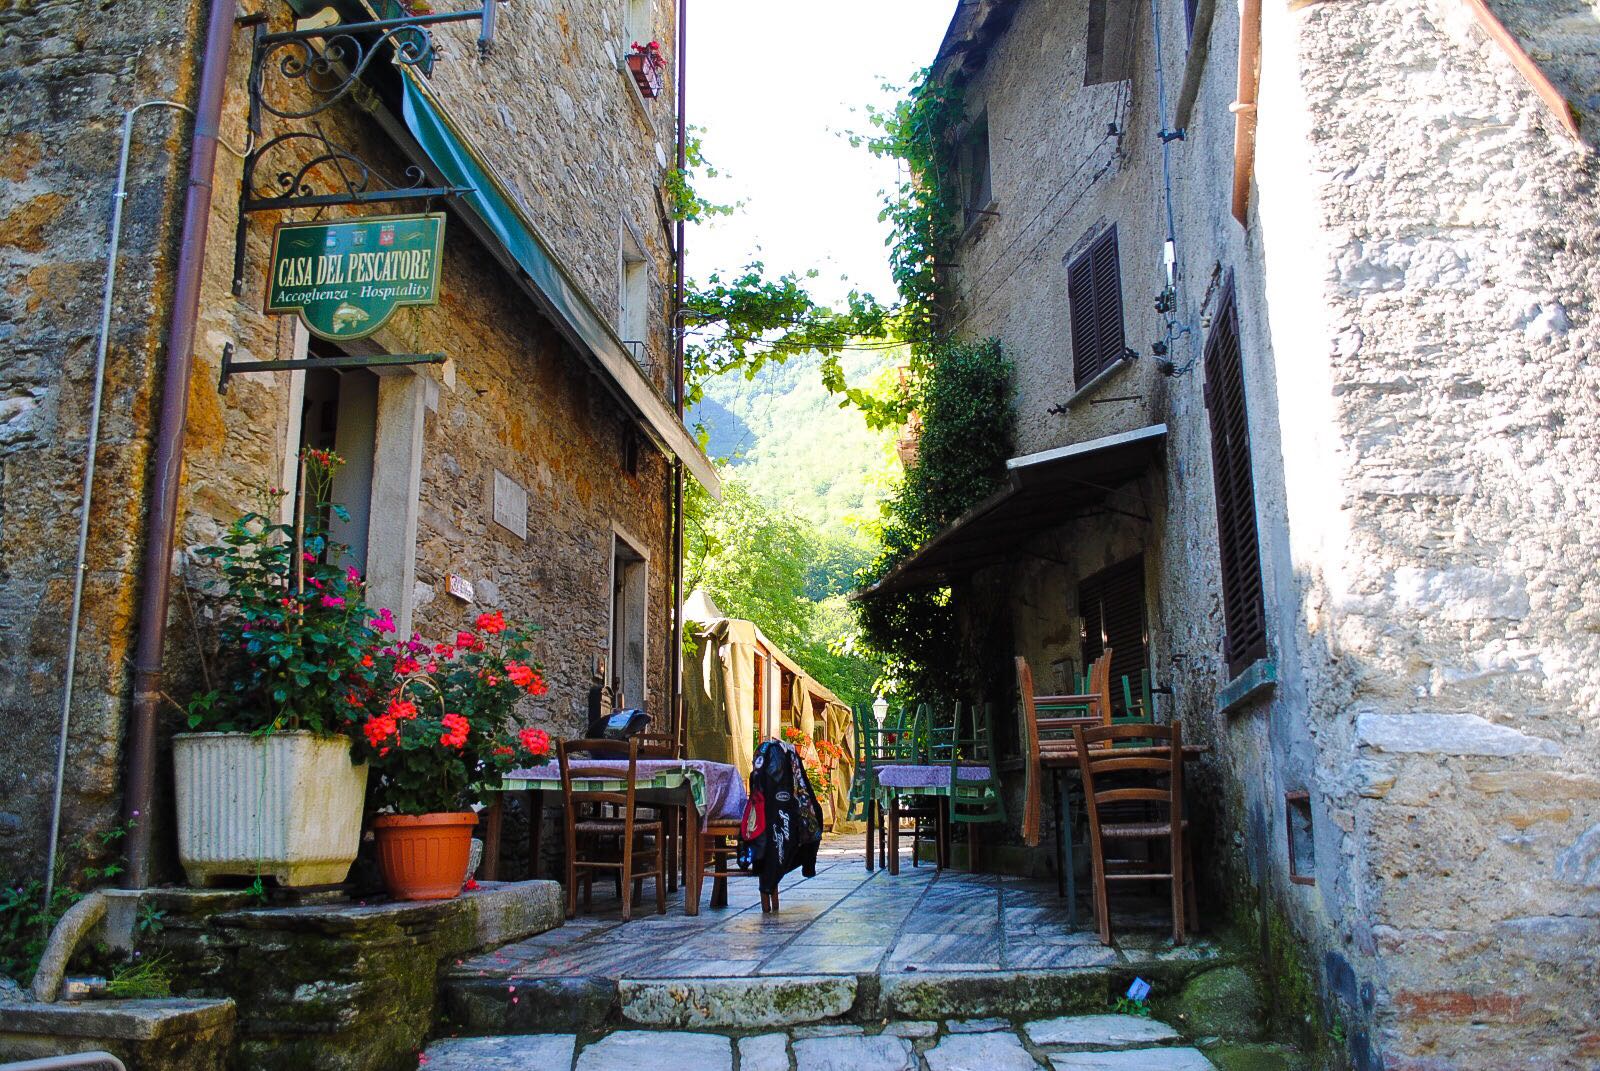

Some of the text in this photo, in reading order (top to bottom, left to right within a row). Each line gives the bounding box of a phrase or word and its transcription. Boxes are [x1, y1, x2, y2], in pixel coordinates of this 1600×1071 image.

[279, 249, 431, 287] CASA DEL PESCATORE
[276, 288, 348, 304] Accoglienza
[360, 283, 429, 300] Hospitality
